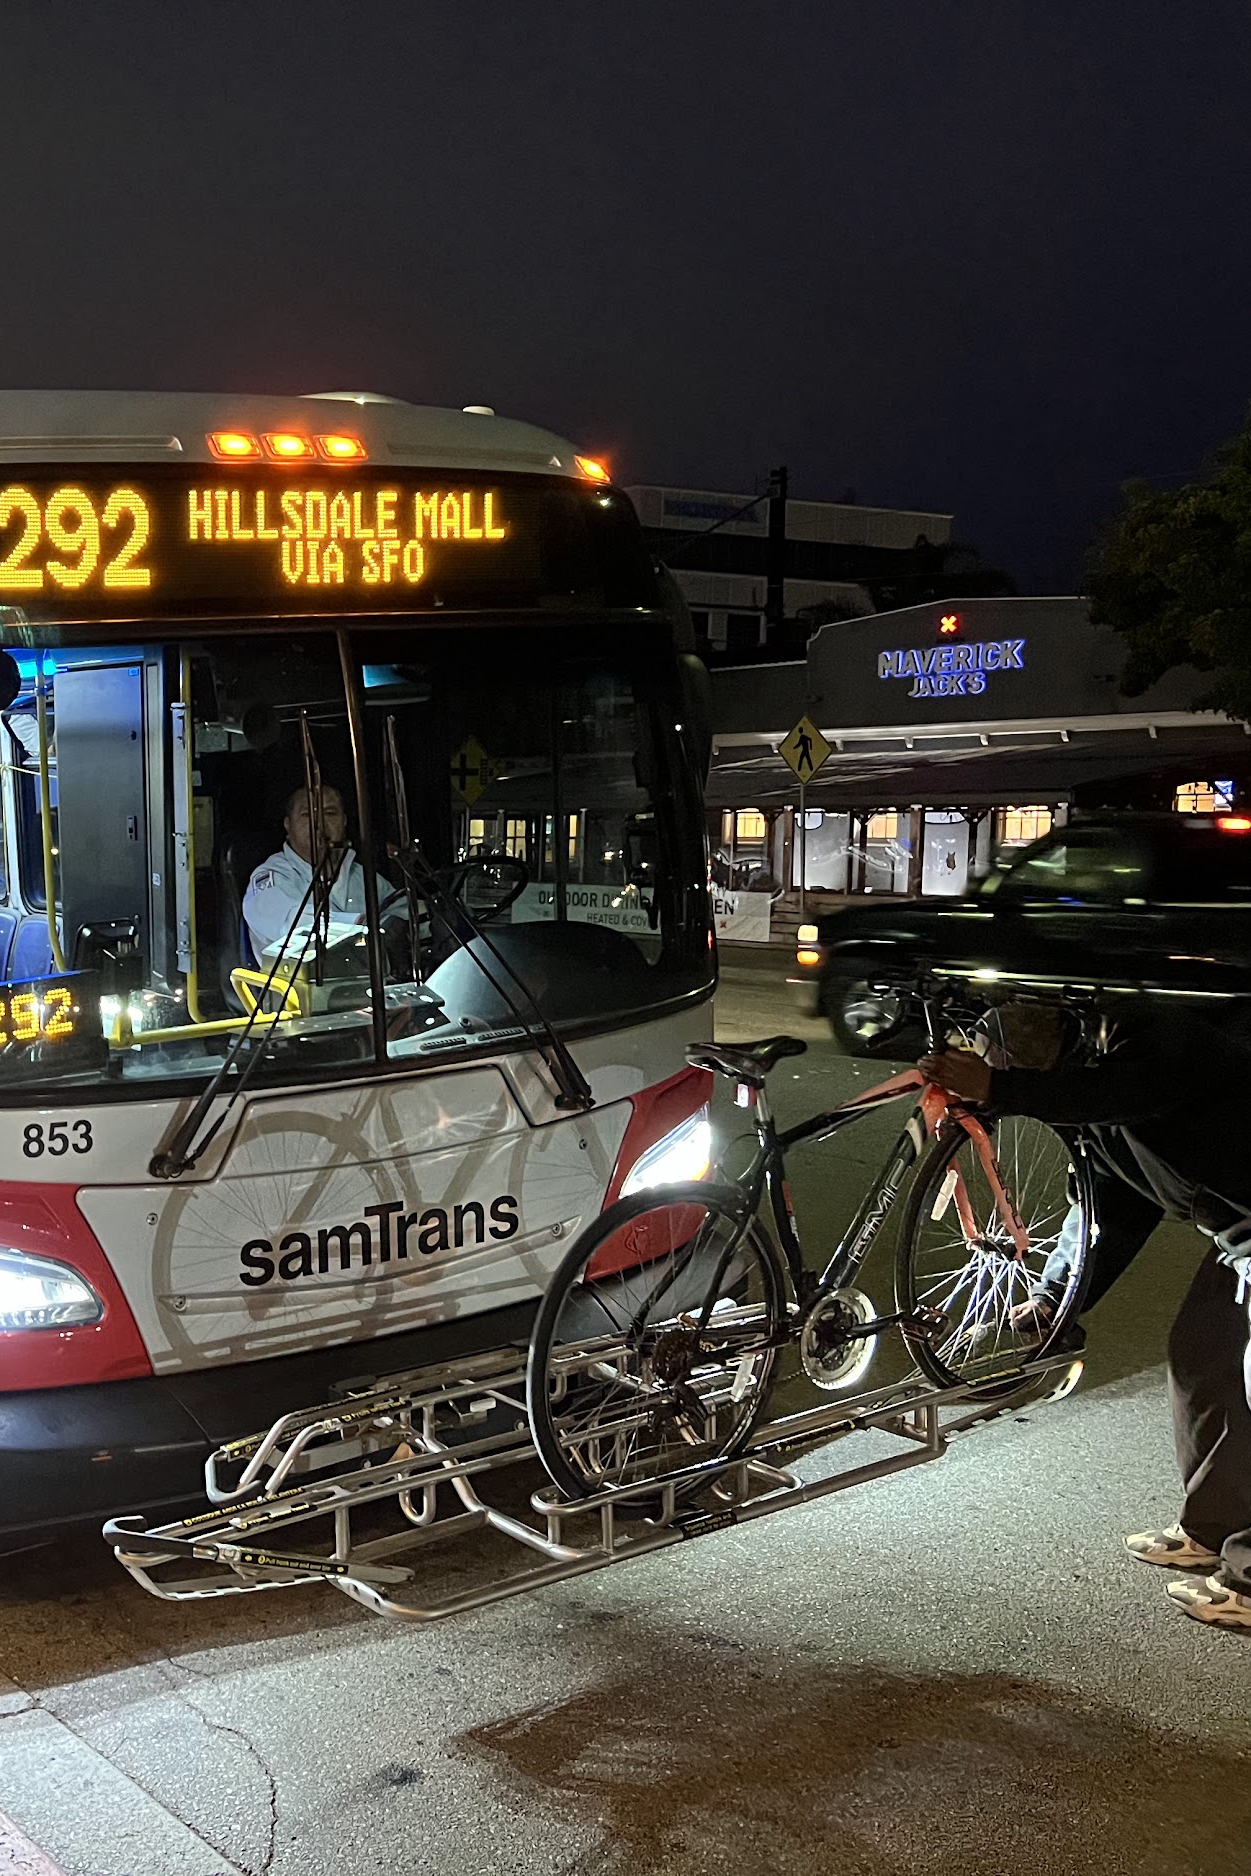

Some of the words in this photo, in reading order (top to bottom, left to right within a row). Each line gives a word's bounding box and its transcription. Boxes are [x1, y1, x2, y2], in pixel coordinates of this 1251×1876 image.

[187, 490, 399, 540] HILLSDALE
[415, 491, 506, 540] MALL
[281, 539, 346, 585] VIA
[360, 539, 425, 585] SFO
[877, 639, 1026, 679] MAVERICK
[907, 672, 987, 698] JACK'S
[538, 890, 598, 908] OUDOOR
[714, 898, 735, 916] EN
[586, 913, 620, 925] HEATED
[622, 916, 629, 925] &
[22, 1119, 93, 1158] 853
[239, 1195, 519, 1286] samTrans
